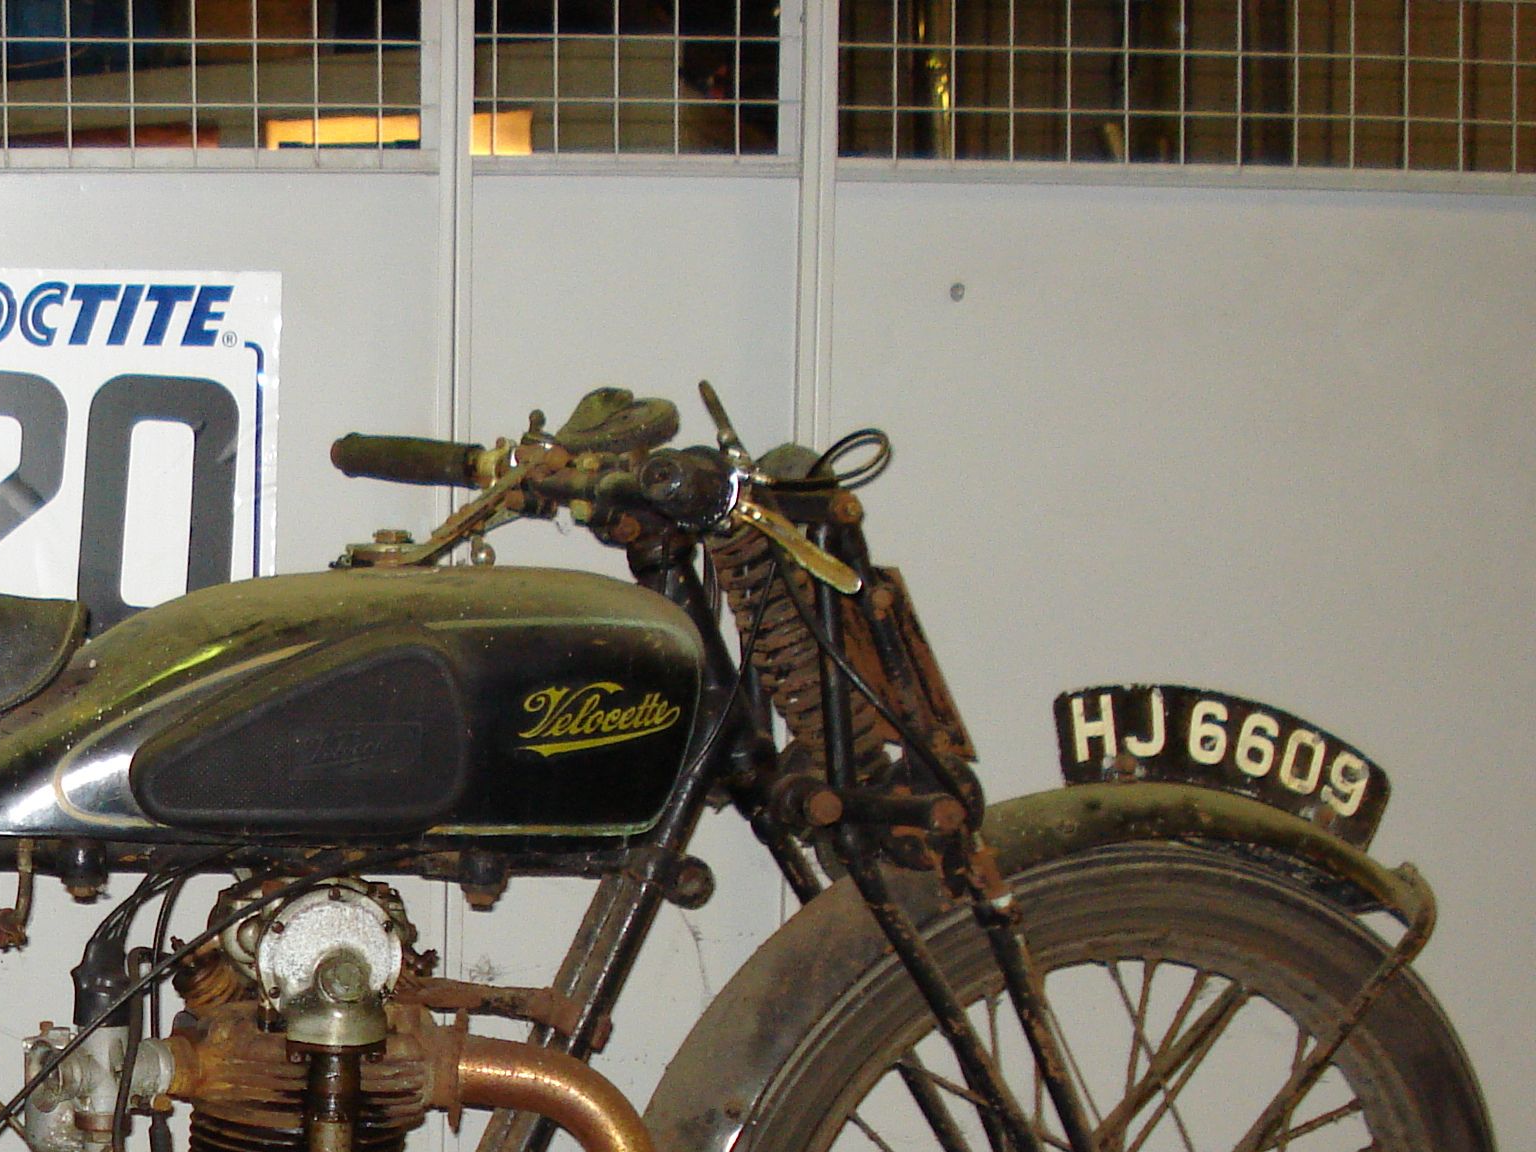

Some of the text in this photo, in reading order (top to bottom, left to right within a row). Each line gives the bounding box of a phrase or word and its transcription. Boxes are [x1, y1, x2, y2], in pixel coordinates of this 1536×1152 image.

[516, 681, 681, 757] Velocette
[1071, 687, 1369, 817] HJ 6609
